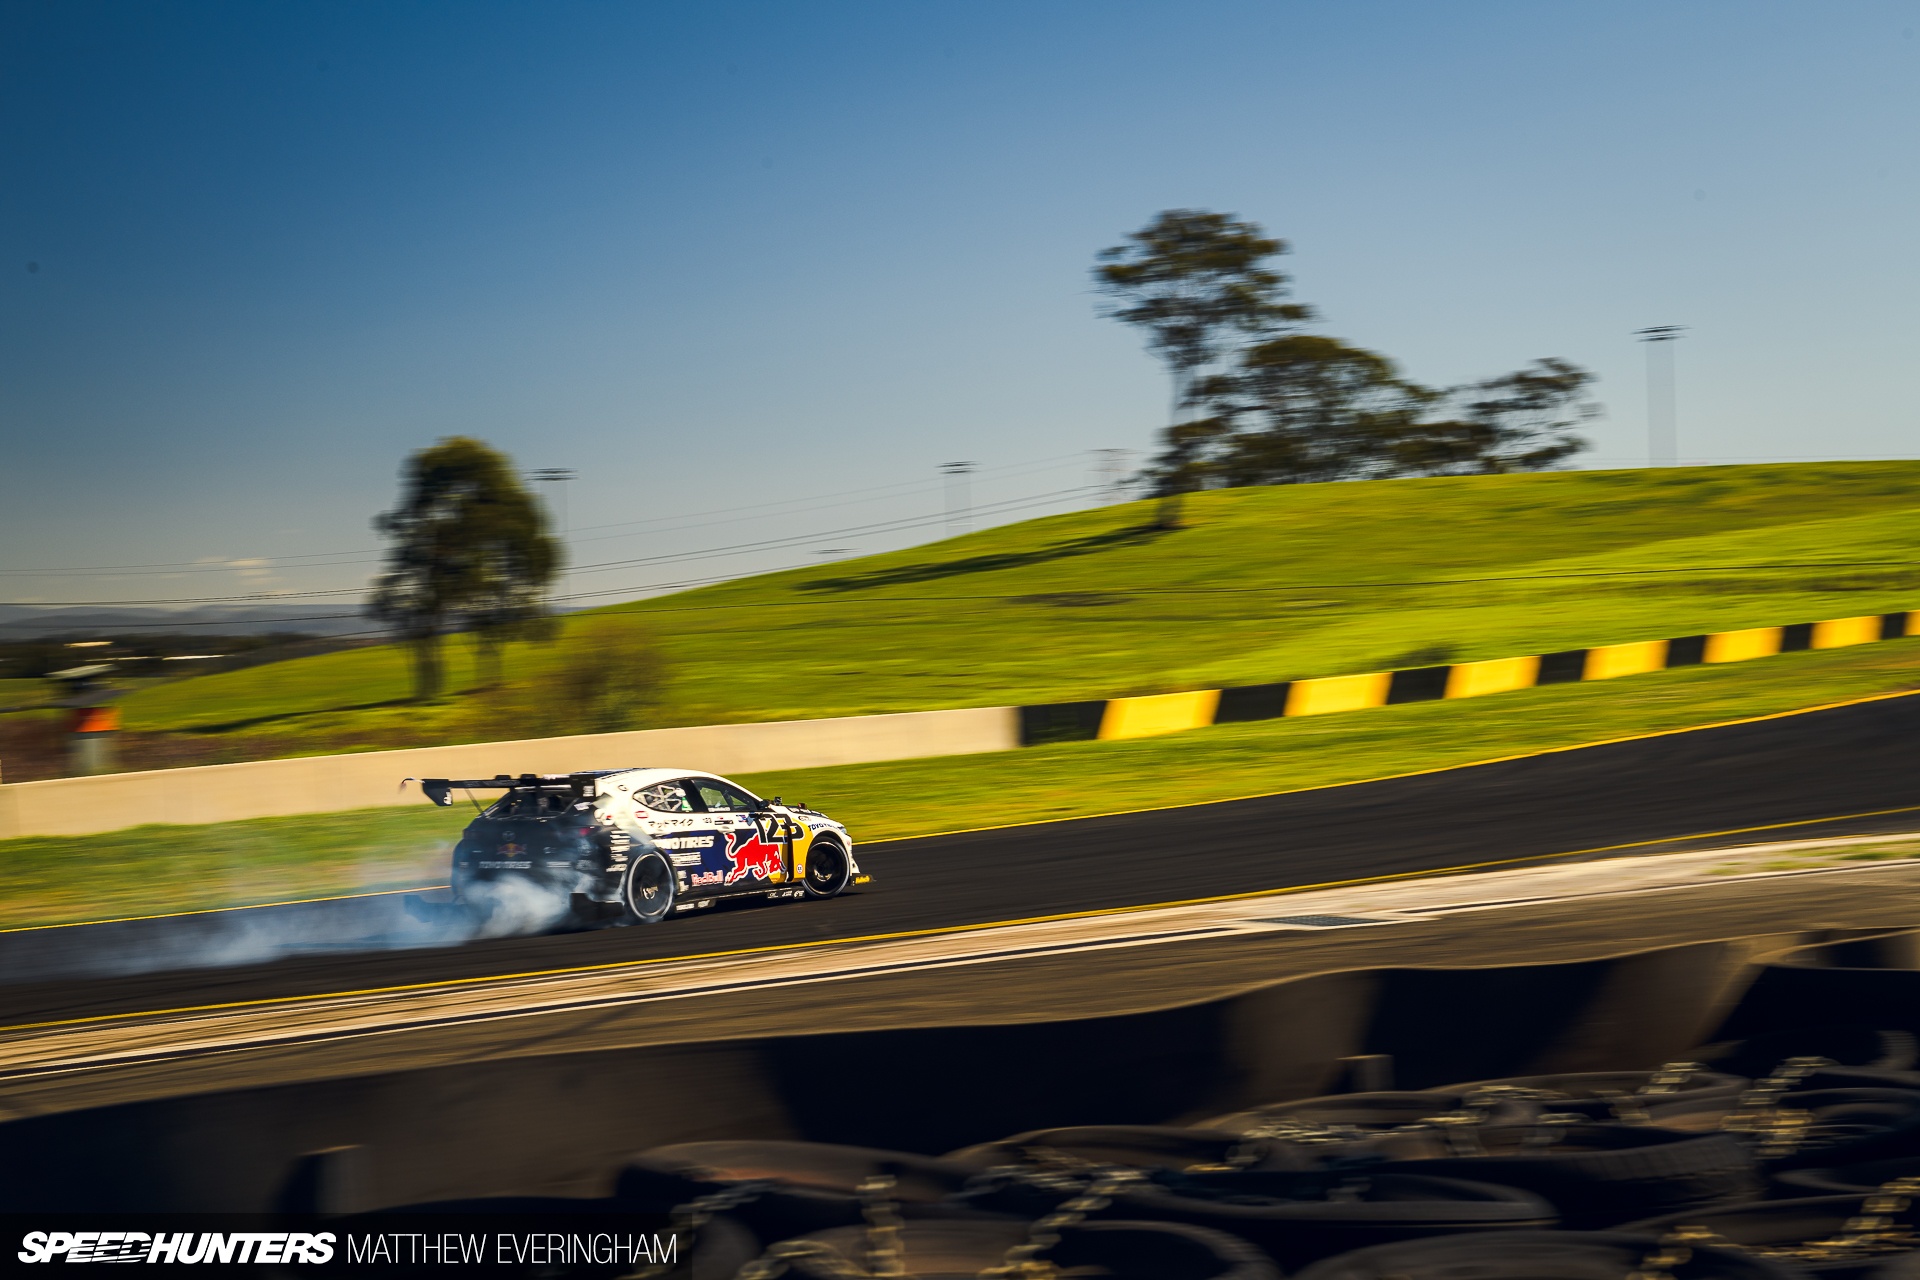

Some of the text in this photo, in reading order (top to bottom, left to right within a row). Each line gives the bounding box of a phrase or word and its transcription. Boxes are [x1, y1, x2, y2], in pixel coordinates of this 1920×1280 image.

[753, 813, 804, 844] 123
[807, 822, 824, 832] TOYO
[680, 835, 715, 849] TIRES
